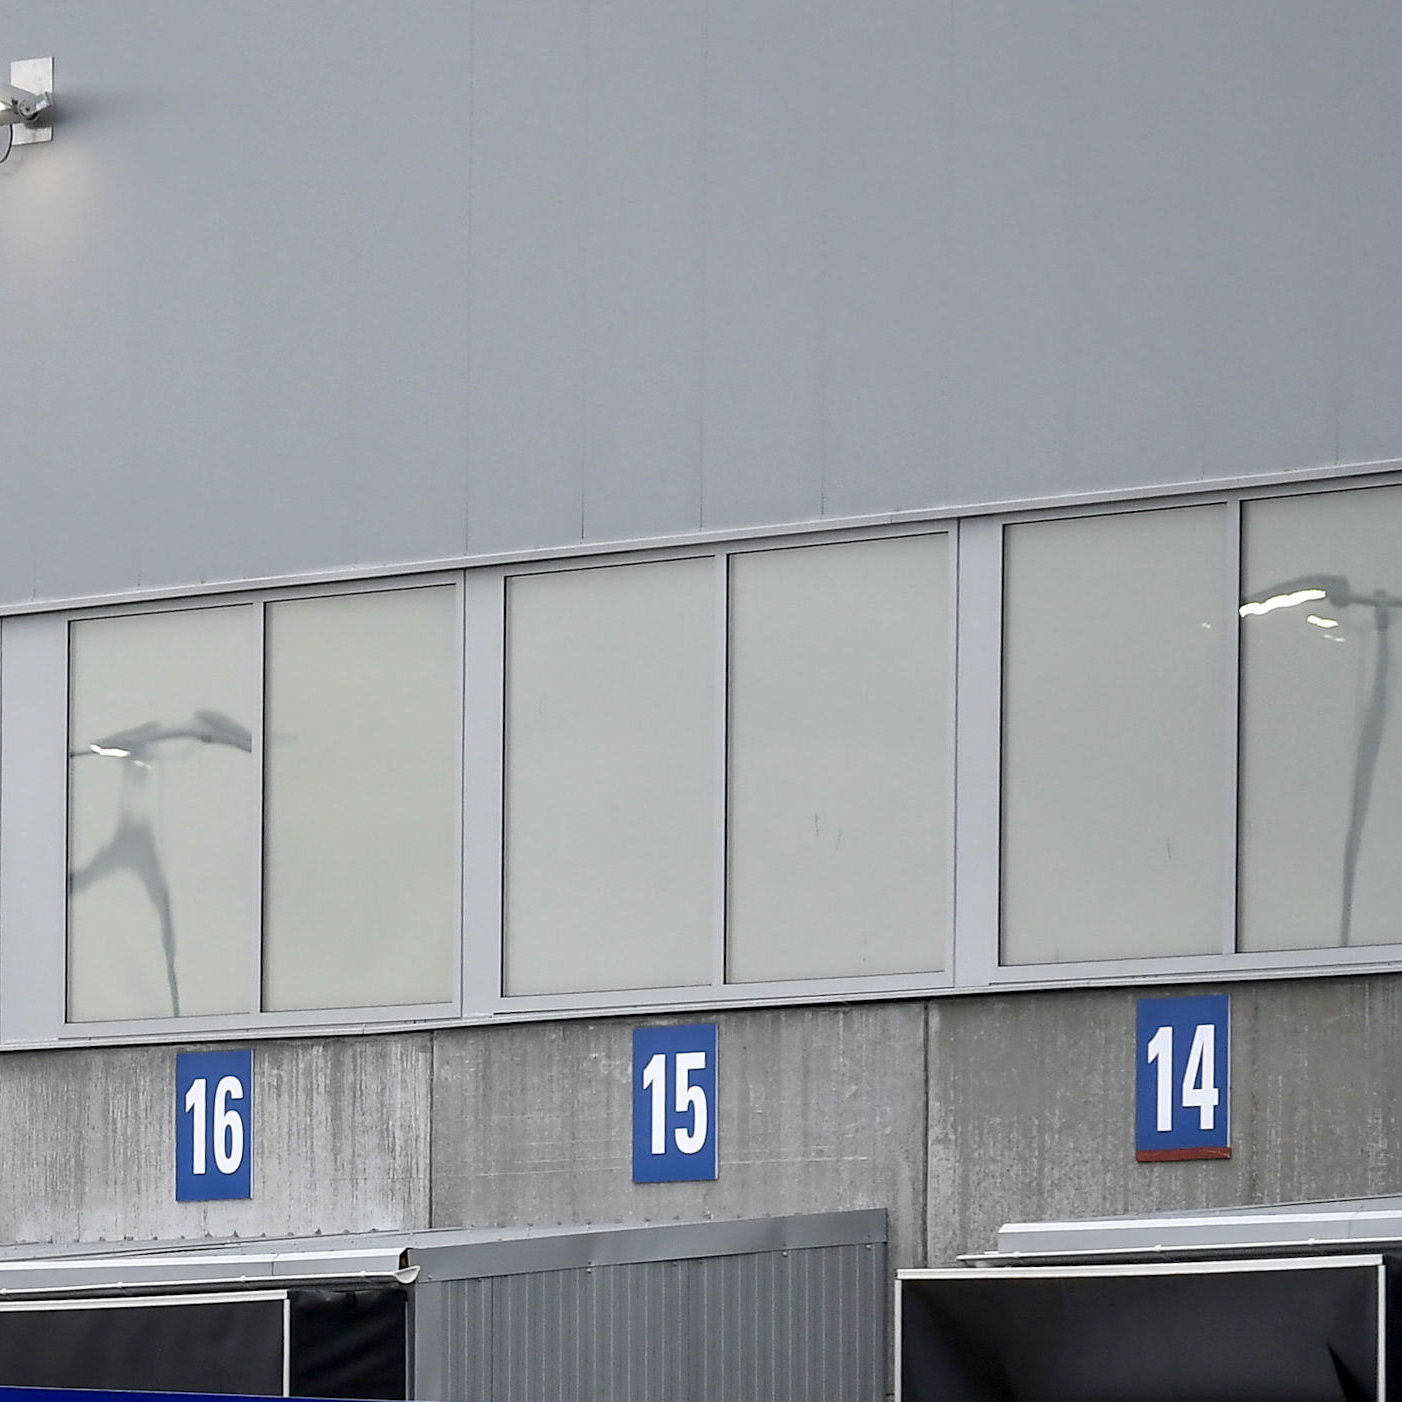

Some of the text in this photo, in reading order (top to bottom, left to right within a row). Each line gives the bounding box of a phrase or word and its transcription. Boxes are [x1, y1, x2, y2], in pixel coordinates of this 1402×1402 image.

[185, 1075, 244, 1175] 16
[642, 1051, 708, 1155] 15
[1147, 1024, 1219, 1132] 14
